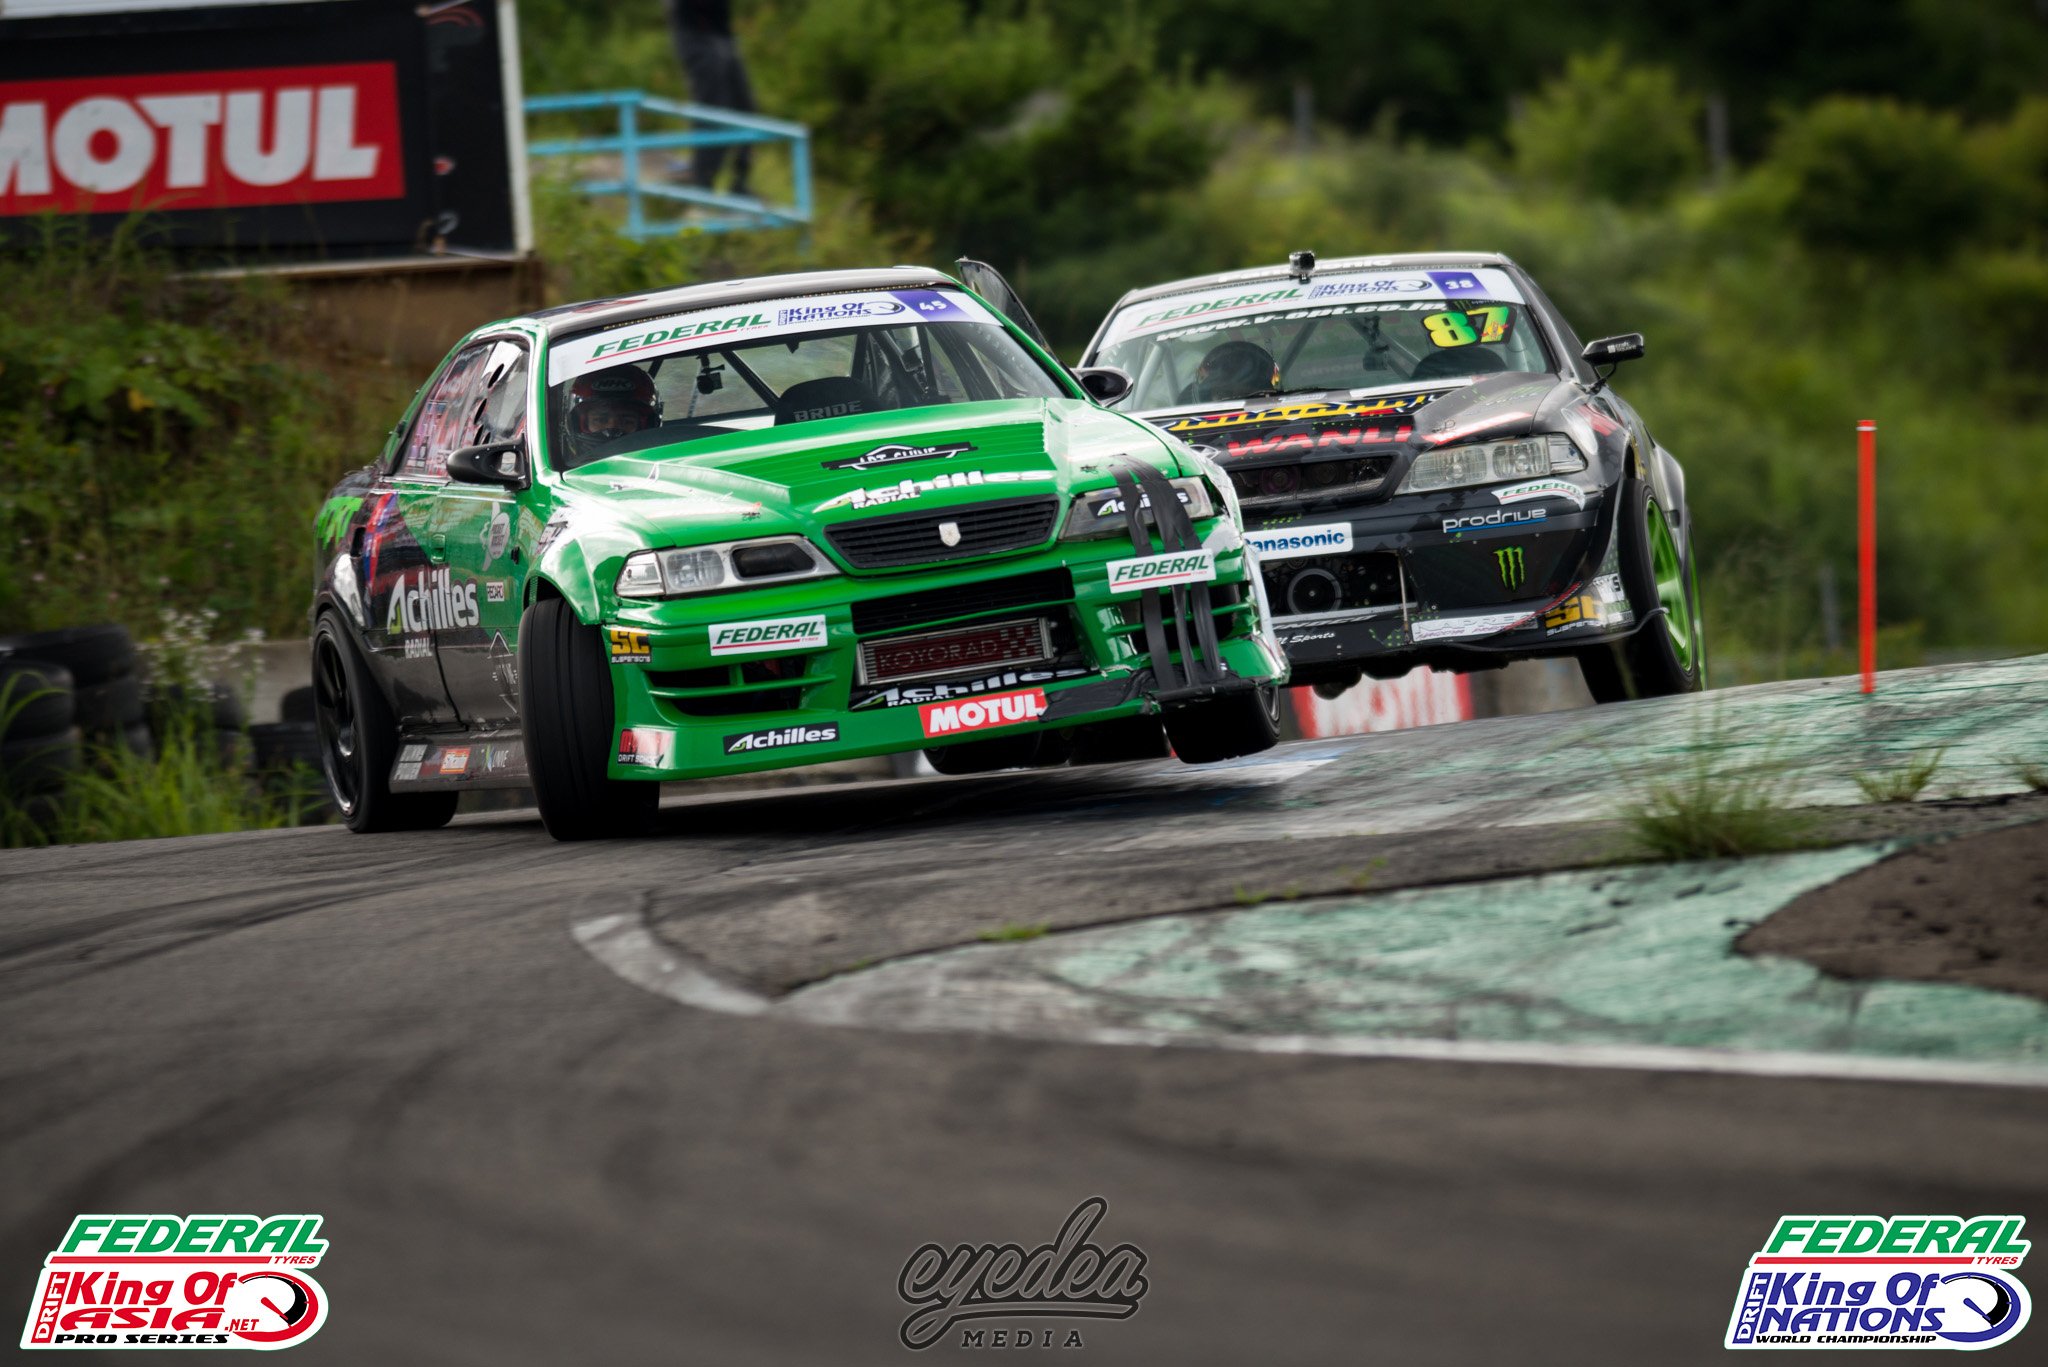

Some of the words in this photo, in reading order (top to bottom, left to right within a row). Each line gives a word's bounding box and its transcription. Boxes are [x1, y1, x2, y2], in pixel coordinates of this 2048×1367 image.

[1444, 279, 1474, 290] 38
[788, 304, 837, 316] King
[841, 302, 865, 311] Of
[788, 309, 873, 322] NATIONS
[919, 300, 947, 312] 45
[1136, 288, 1303, 326] FEDERAL
[592, 313, 772, 358] FEDERAL
[1423, 306, 1510, 348] 87
[793, 400, 864, 421] BRIDE
[1225, 425, 1413, 457] WANLI
[853, 490, 921, 510] RADIAL
[1442, 508, 1547, 534] prodrive
[1114, 555, 1209, 581] FEDERAL
[386, 568, 480, 635] Achilles
[716, 621, 822, 645] FEDERAL
[405, 637, 433, 659] RADIAL
[878, 638, 999, 671] KOYORAD
[850, 668, 1089, 711] Achilles
[887, 694, 954, 707] RADIAL
[929, 693, 1048, 734] MOTUL
[727, 726, 837, 753] Achilles
